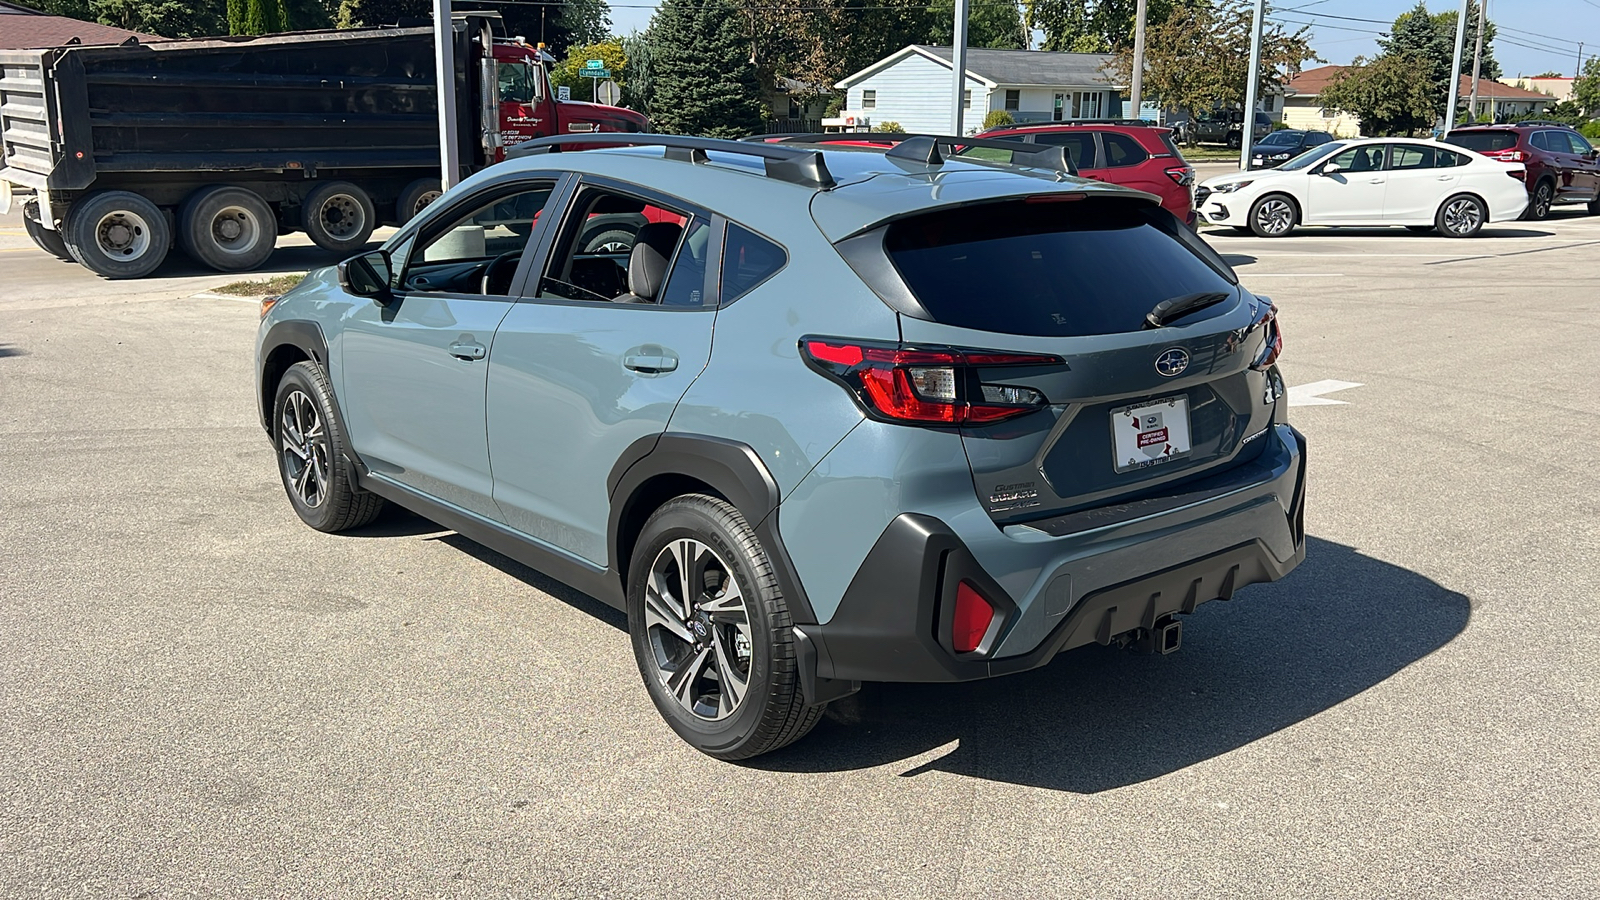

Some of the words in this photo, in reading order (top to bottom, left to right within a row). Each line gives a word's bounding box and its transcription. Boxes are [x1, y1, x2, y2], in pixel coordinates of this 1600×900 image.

[1140, 435, 1167, 446] PRE-OWNED
[1141, 430, 1164, 440] CERTIFIED
[990, 490, 1038, 503] SUBARU
